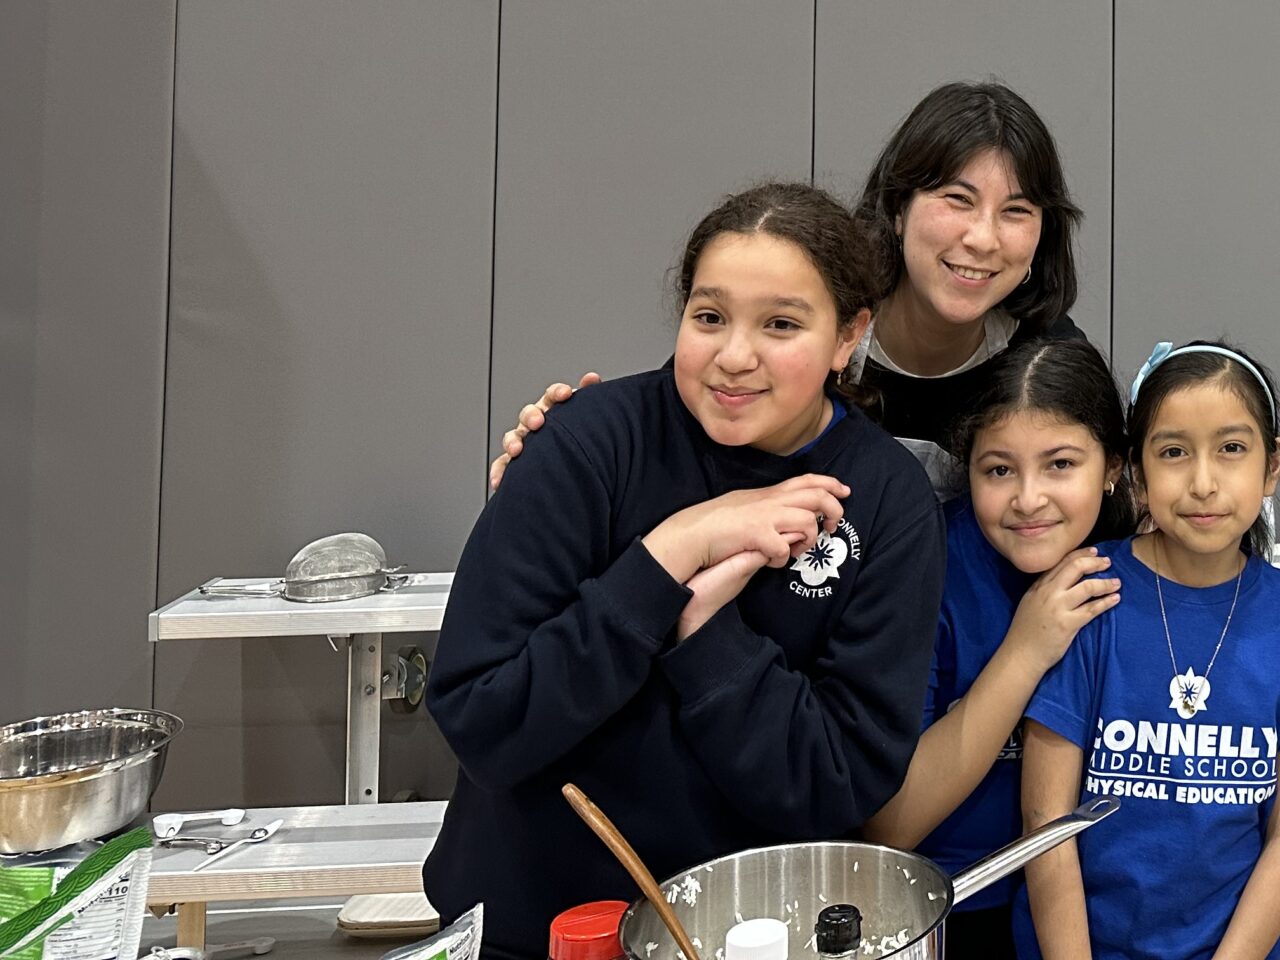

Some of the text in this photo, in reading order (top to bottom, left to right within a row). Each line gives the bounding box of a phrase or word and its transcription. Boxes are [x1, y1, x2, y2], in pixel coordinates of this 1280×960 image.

[837, 517, 861, 561] ONNELLY
[789, 581, 833, 599] CENTER
[1086, 775, 1276, 805] HYSICAL EDUCATION
